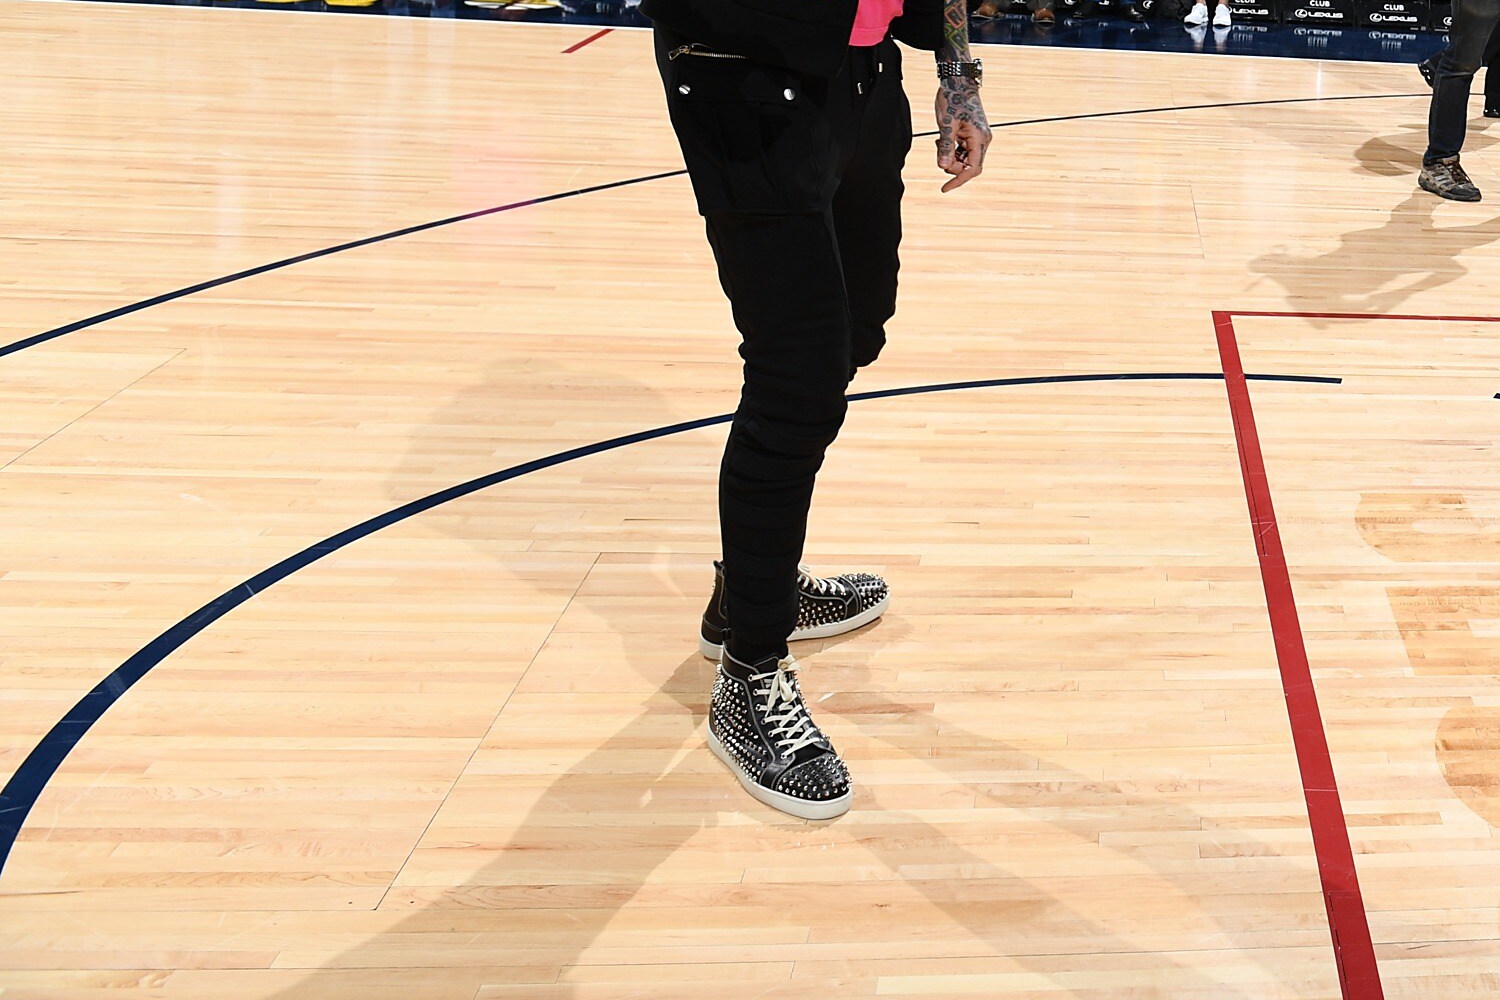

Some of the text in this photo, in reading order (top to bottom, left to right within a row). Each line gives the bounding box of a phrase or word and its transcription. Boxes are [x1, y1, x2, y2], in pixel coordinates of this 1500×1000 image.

[1232, 8, 1269, 16] LEXUS
[1307, 11, 1344, 19] LEXUS
[1382, 15, 1418, 23] LEXUS
